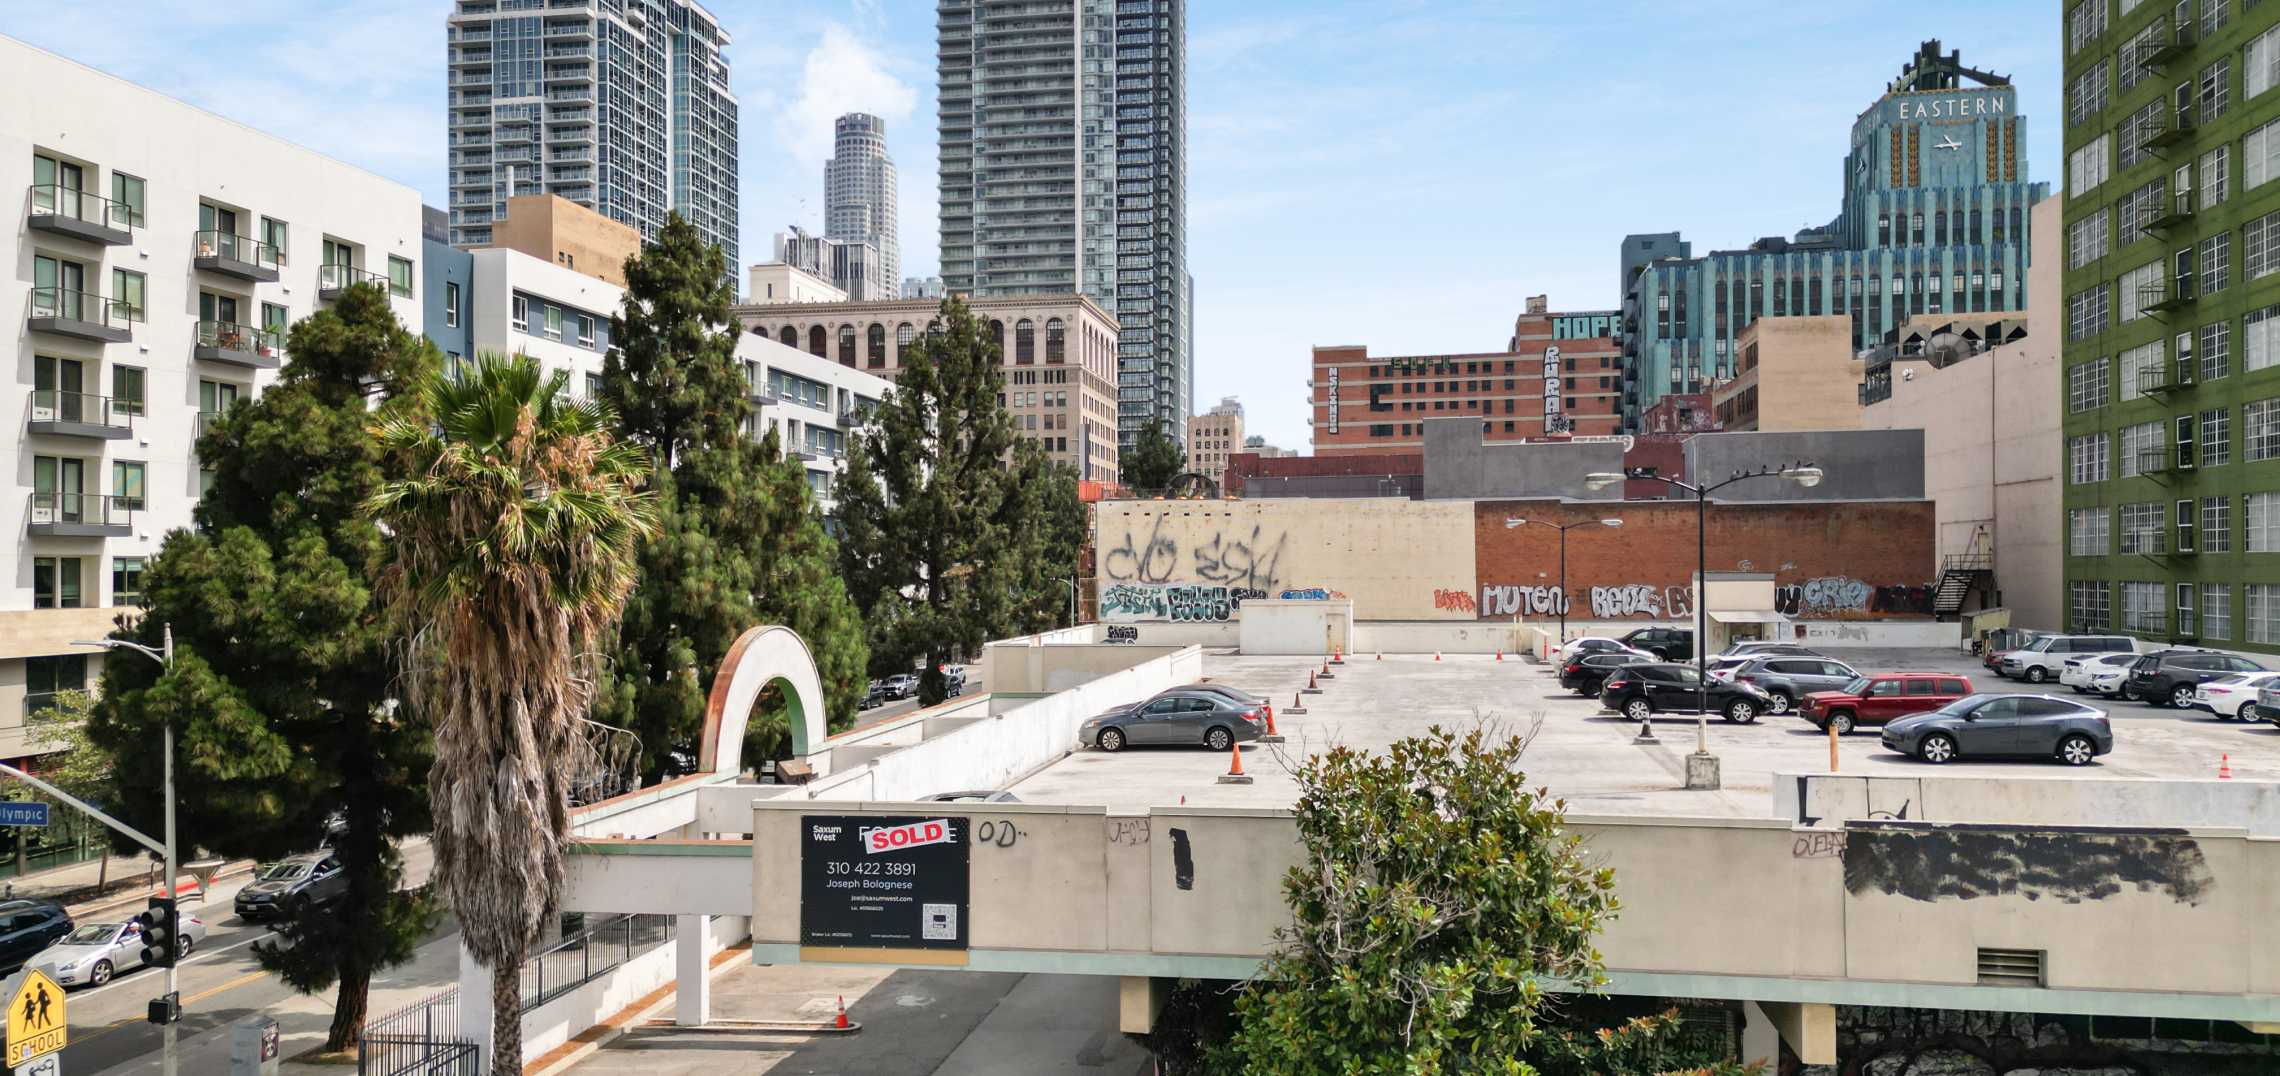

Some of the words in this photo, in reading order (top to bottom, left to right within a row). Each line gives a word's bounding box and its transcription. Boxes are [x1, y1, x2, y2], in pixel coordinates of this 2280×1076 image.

[1900, 96, 2004, 119] EASTERN
[1552, 315, 1622, 340] HOPE
[0, 808, 43, 823] lympic
[812, 825, 842, 834] Saxum
[813, 833, 836, 841] West
[872, 823, 943, 849] SOLD
[826, 862, 850, 875] 310
[854, 862, 881, 875] 422
[884, 862, 916, 876] 3891
[826, 880, 861, 889] Joseph
[863, 880, 913, 890] Bolognese
[12, 1031, 63, 1060] SCHOOL
